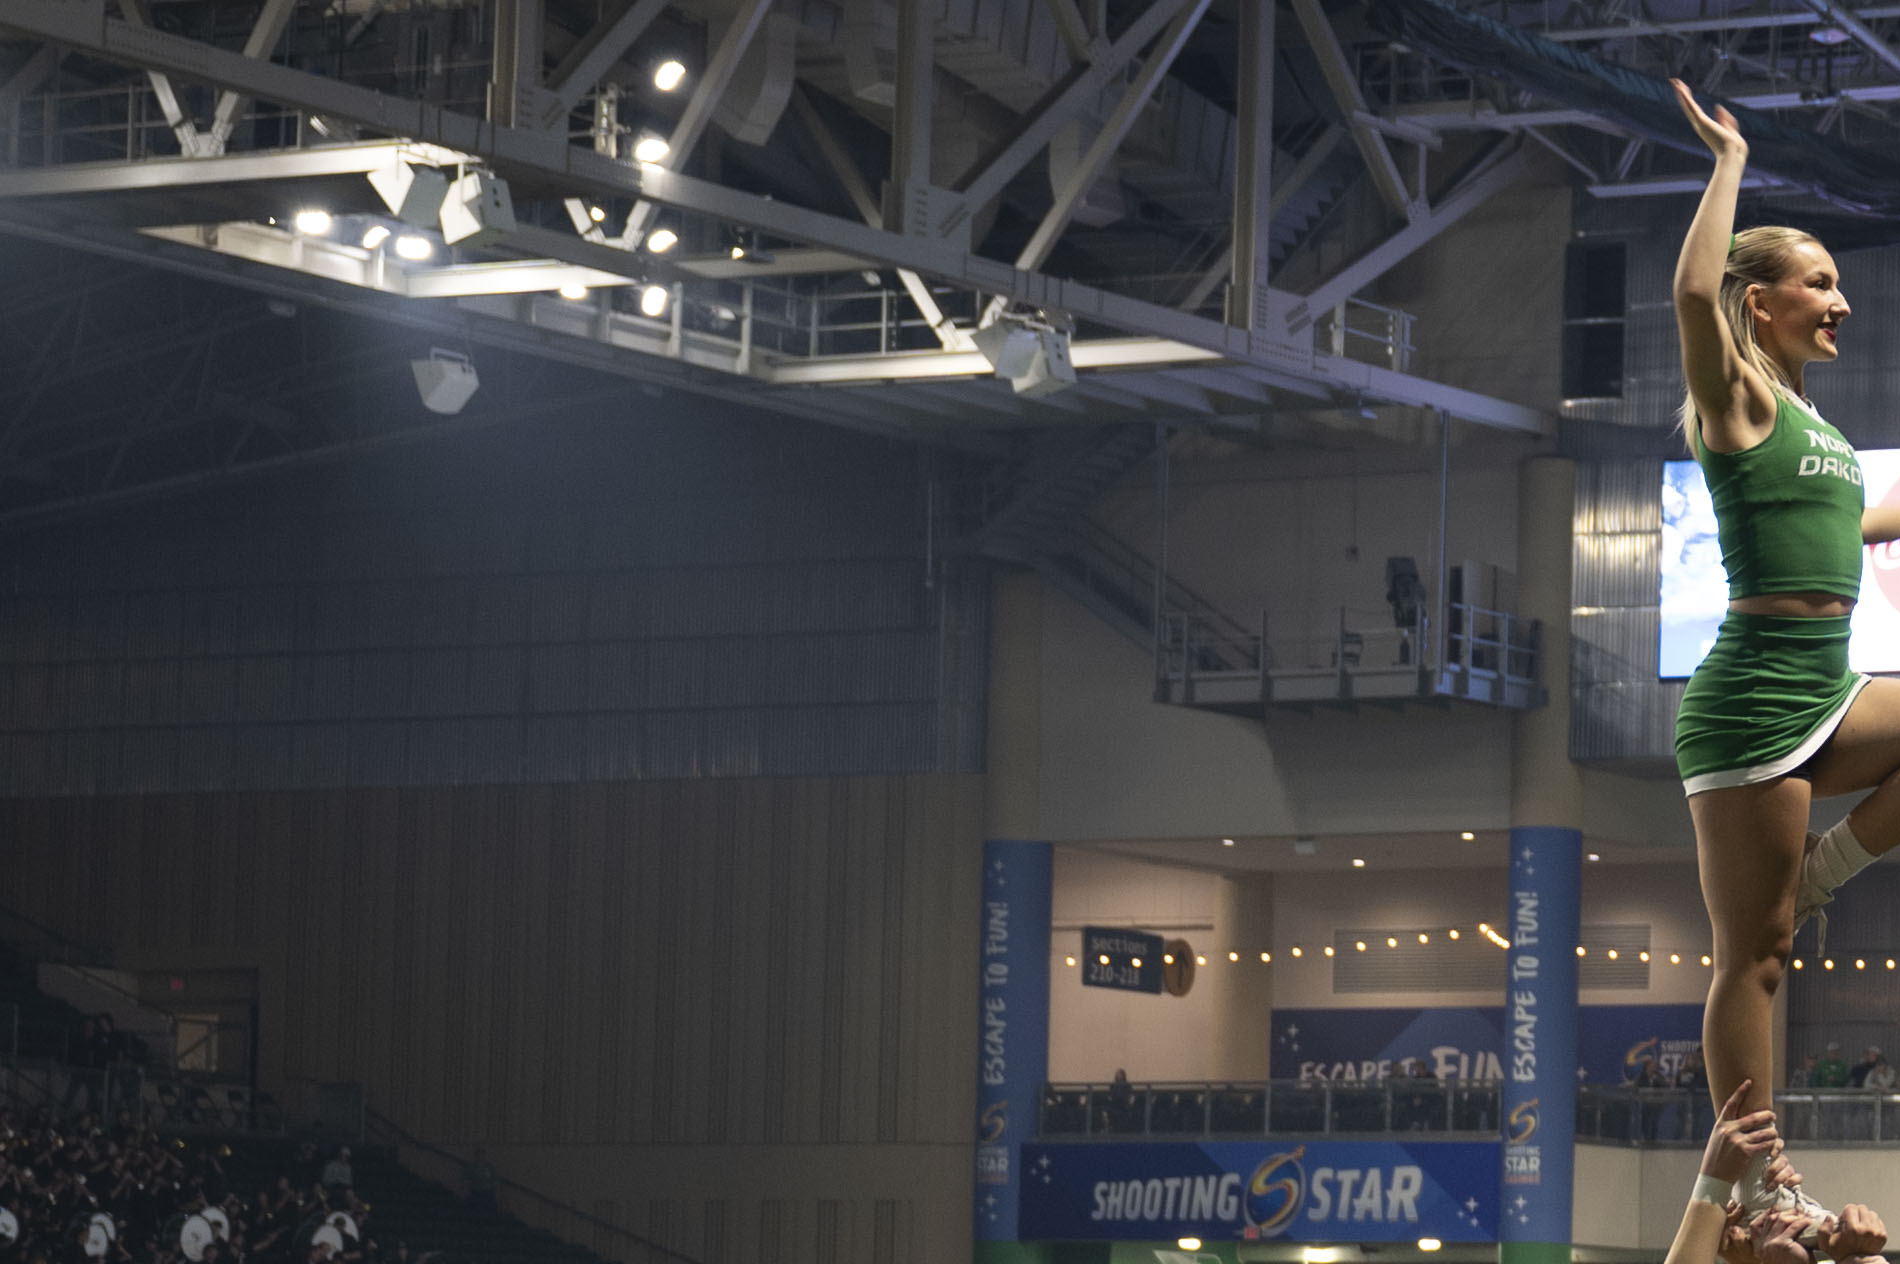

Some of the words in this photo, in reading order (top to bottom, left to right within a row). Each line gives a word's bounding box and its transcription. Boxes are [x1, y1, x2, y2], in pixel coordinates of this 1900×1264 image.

[1798, 455, 1862, 486] DAKO
[985, 901, 1009, 956] FUN!
[1513, 891, 1539, 947] FUN!
[984, 962, 1009, 987] TO
[1513, 955, 1540, 981] TO
[984, 997, 1007, 1086] ESCAPE
[1512, 991, 1538, 1083] ESCAPE
[1505, 1156, 1541, 1173] STAR
[1091, 1172, 1241, 1222] SHOOTING
[1307, 1165, 1424, 1223] STAR
